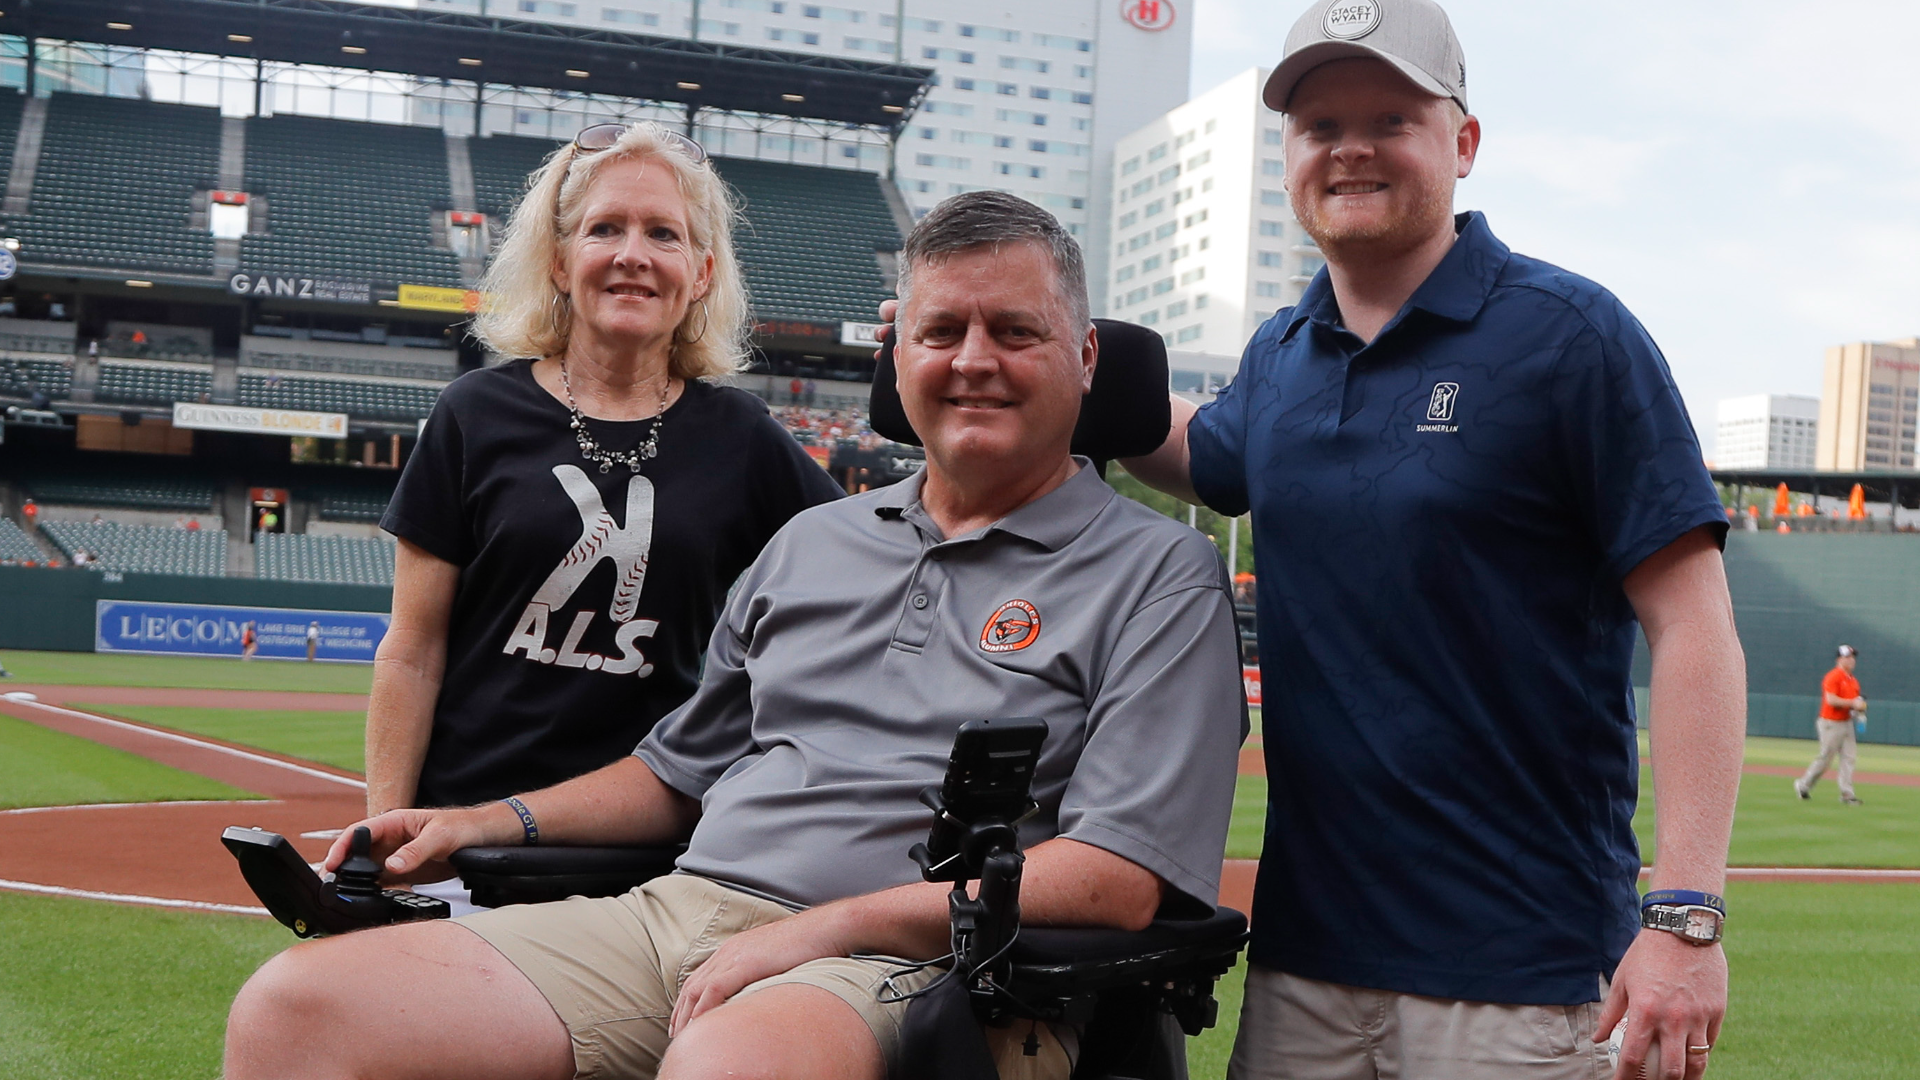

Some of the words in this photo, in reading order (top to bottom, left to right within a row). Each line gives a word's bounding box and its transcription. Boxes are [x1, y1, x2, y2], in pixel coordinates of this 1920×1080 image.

[1331, 6, 1372, 16] STACEY
[1331, 13, 1371, 24] WYATT
[230, 273, 314, 299] GANZ
[177, 405, 259, 425] GUINNESS
[262, 412, 322, 430] BLONDE
[1416, 424, 1459, 432] SUMMERLIN
[257, 623, 283, 633] LAKE
[502, 602, 660, 679] A.L.S.
[523, 814, 536, 829] GT
